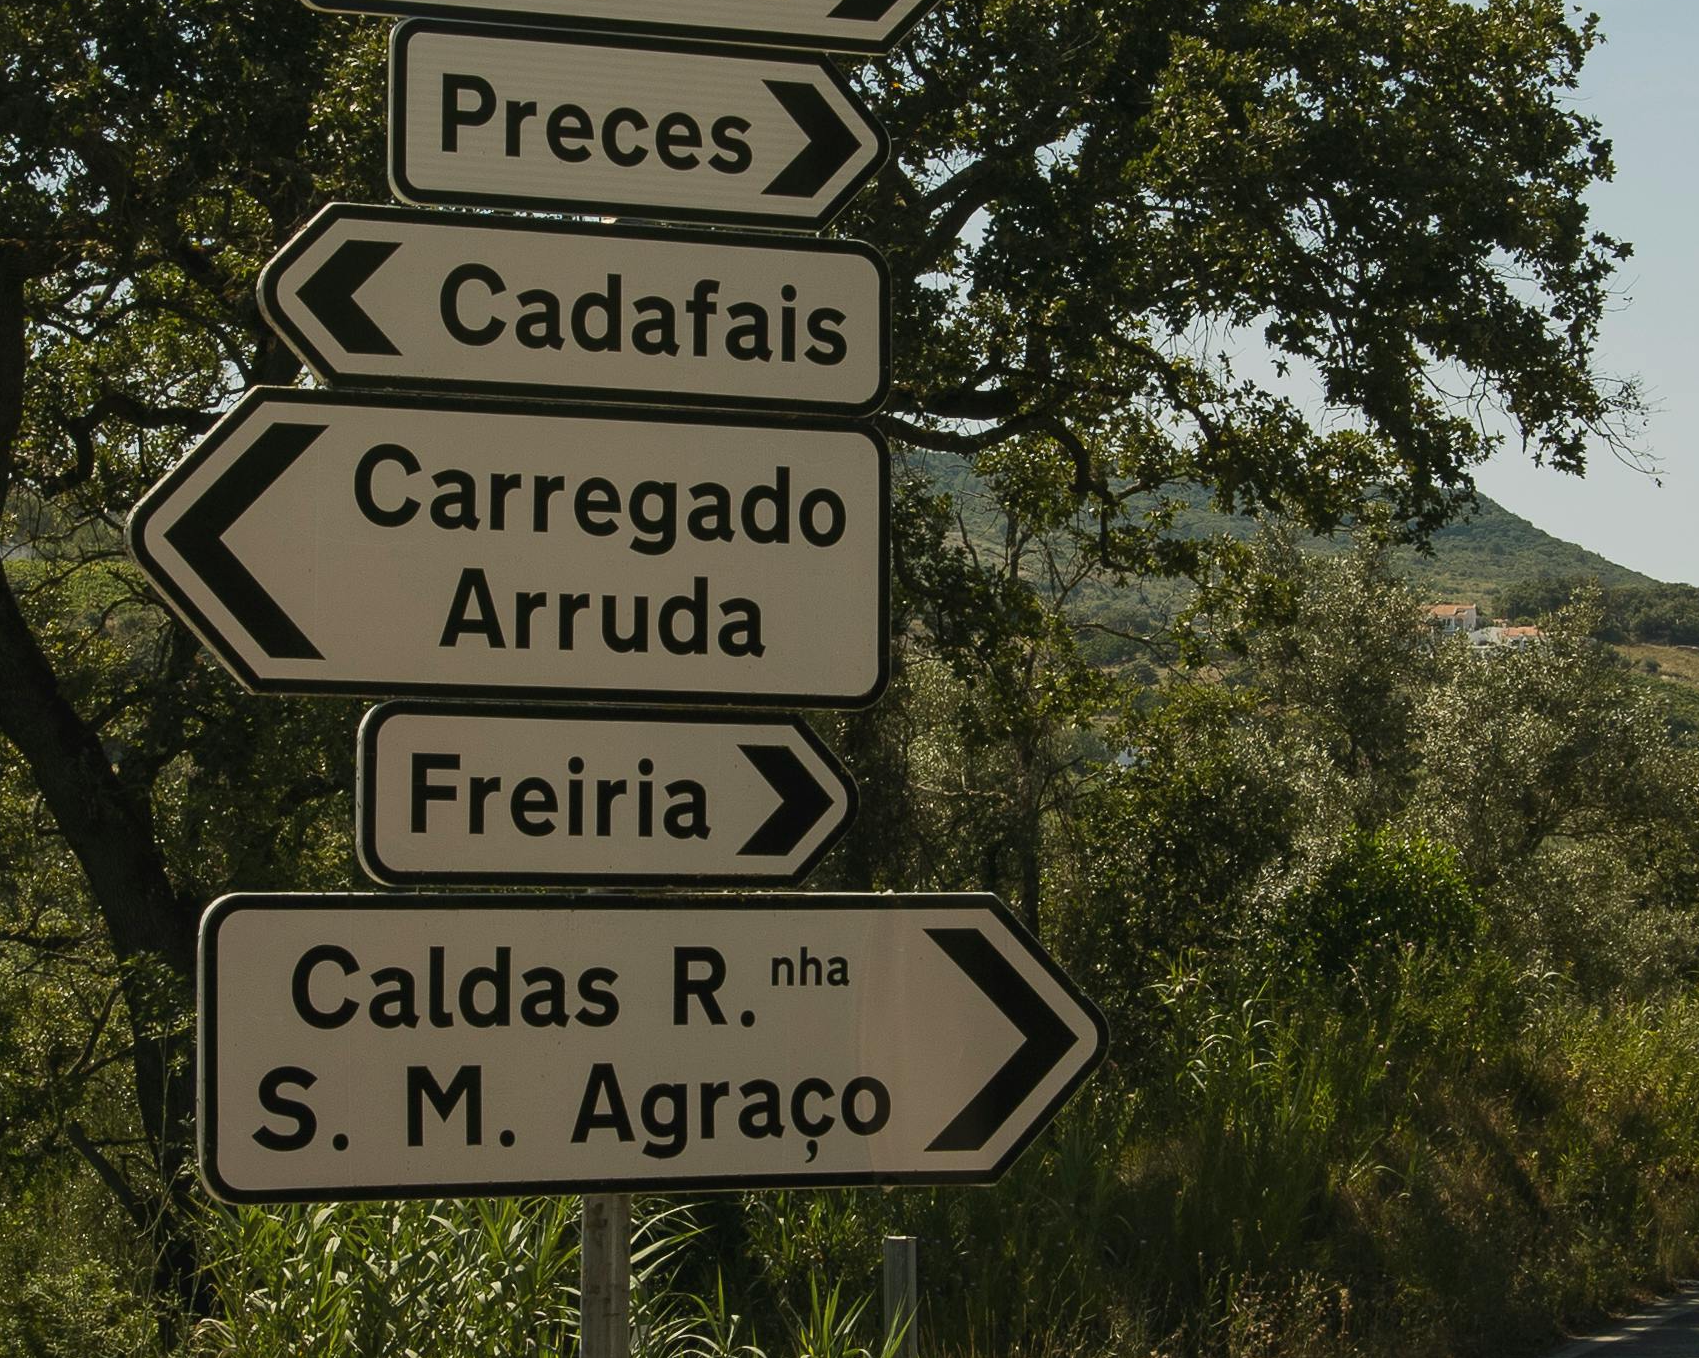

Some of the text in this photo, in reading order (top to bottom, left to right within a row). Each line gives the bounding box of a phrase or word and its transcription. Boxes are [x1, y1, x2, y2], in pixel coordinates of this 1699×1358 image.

[442, 73, 752, 174] Preces
[440, 264, 847, 365] Cadafais
[355, 444, 846, 555] Carregado
[439, 568, 766, 657] Arruda
[411, 753, 711, 840] Freiria
[292, 945, 849, 1029] Caldas R. nha
[252, 1063, 890, 1163] S. M. Agraço
